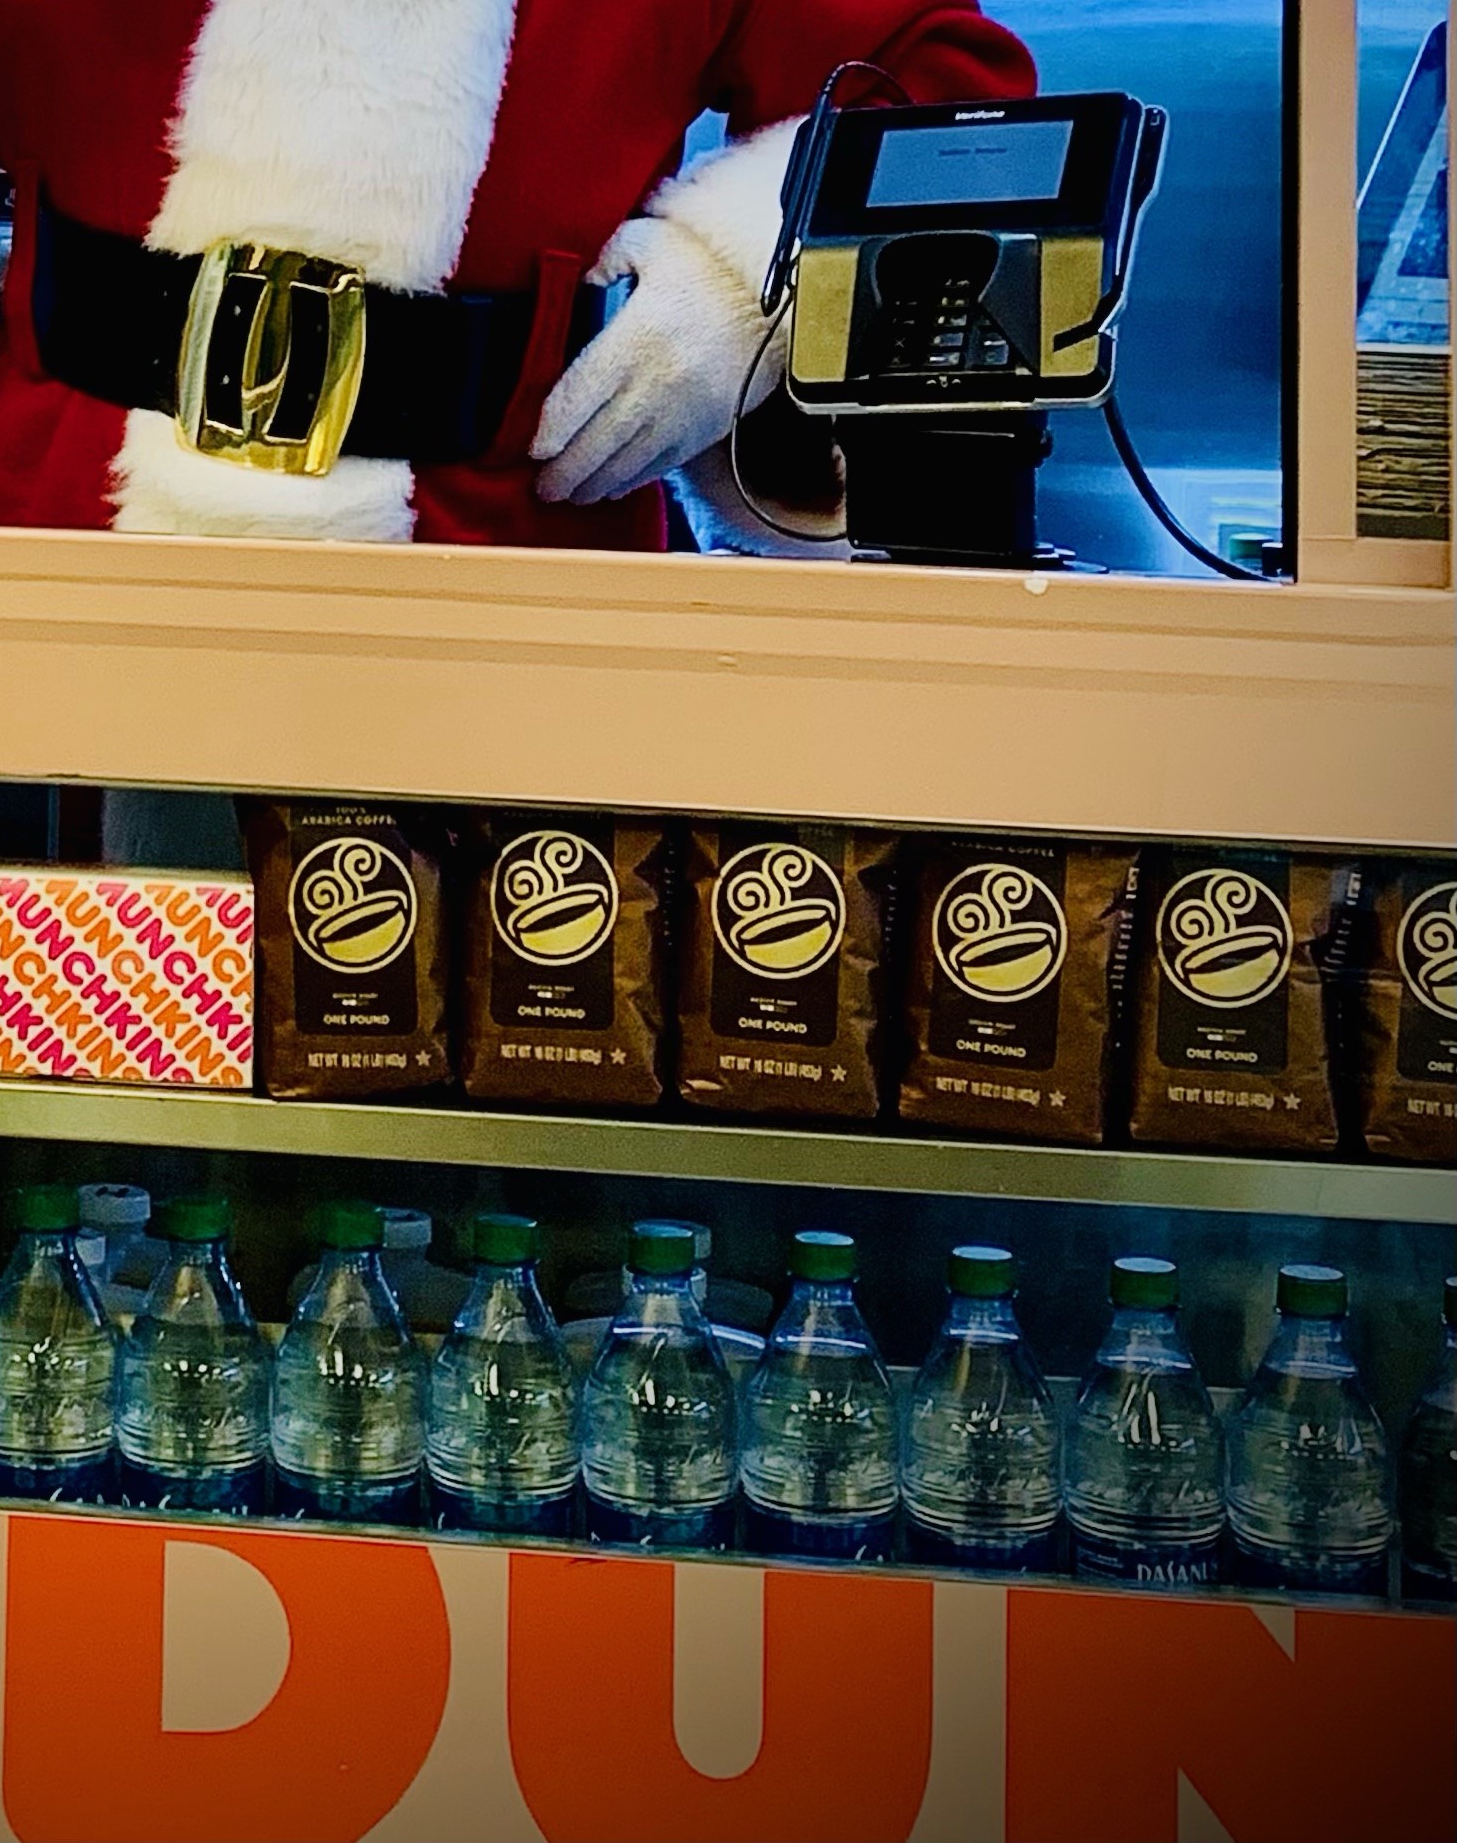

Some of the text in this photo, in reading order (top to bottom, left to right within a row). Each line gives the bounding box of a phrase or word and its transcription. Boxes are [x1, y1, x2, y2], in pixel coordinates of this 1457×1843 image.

[323, 1014, 390, 1025] ONE POUND
[517, 1005, 586, 1019] ONE POUND
[738, 1017, 808, 1034] ONE POUND
[956, 1039, 1027, 1057] ONE POUND
[1186, 1047, 1258, 1063] ONE POUND
[1427, 1060, 1454, 1074] ONE
